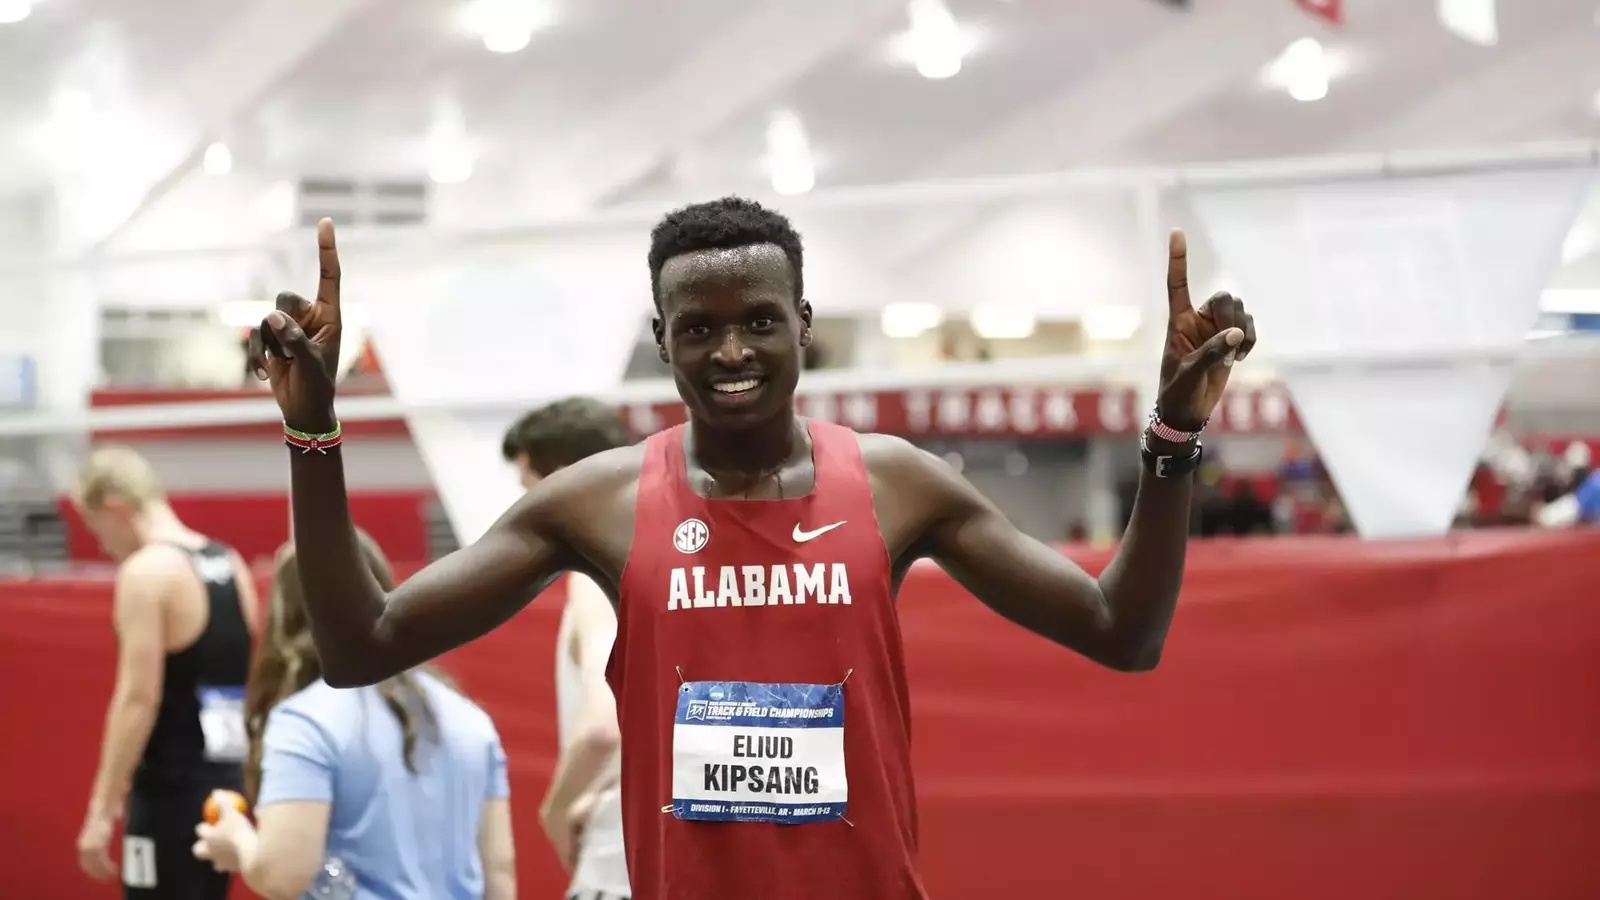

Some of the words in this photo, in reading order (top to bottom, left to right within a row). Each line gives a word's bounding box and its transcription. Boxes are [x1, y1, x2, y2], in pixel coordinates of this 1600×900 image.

[676, 520, 707, 551] SEC
[667, 562, 852, 611] ALABAMA
[707, 706, 736, 716] TRACK
[735, 707, 743, 717] &
[743, 707, 769, 717] FIELD
[769, 707, 834, 719] CHAMPIONSHIPS
[733, 734, 793, 759] ELIUD
[704, 763, 819, 795] KIPSANG
[690, 803, 721, 814] DIVISION
[730, 805, 777, 816] FAYETTEVILLE,
[777, 807, 788, 816] AR
[792, 807, 818, 817] MARCH
